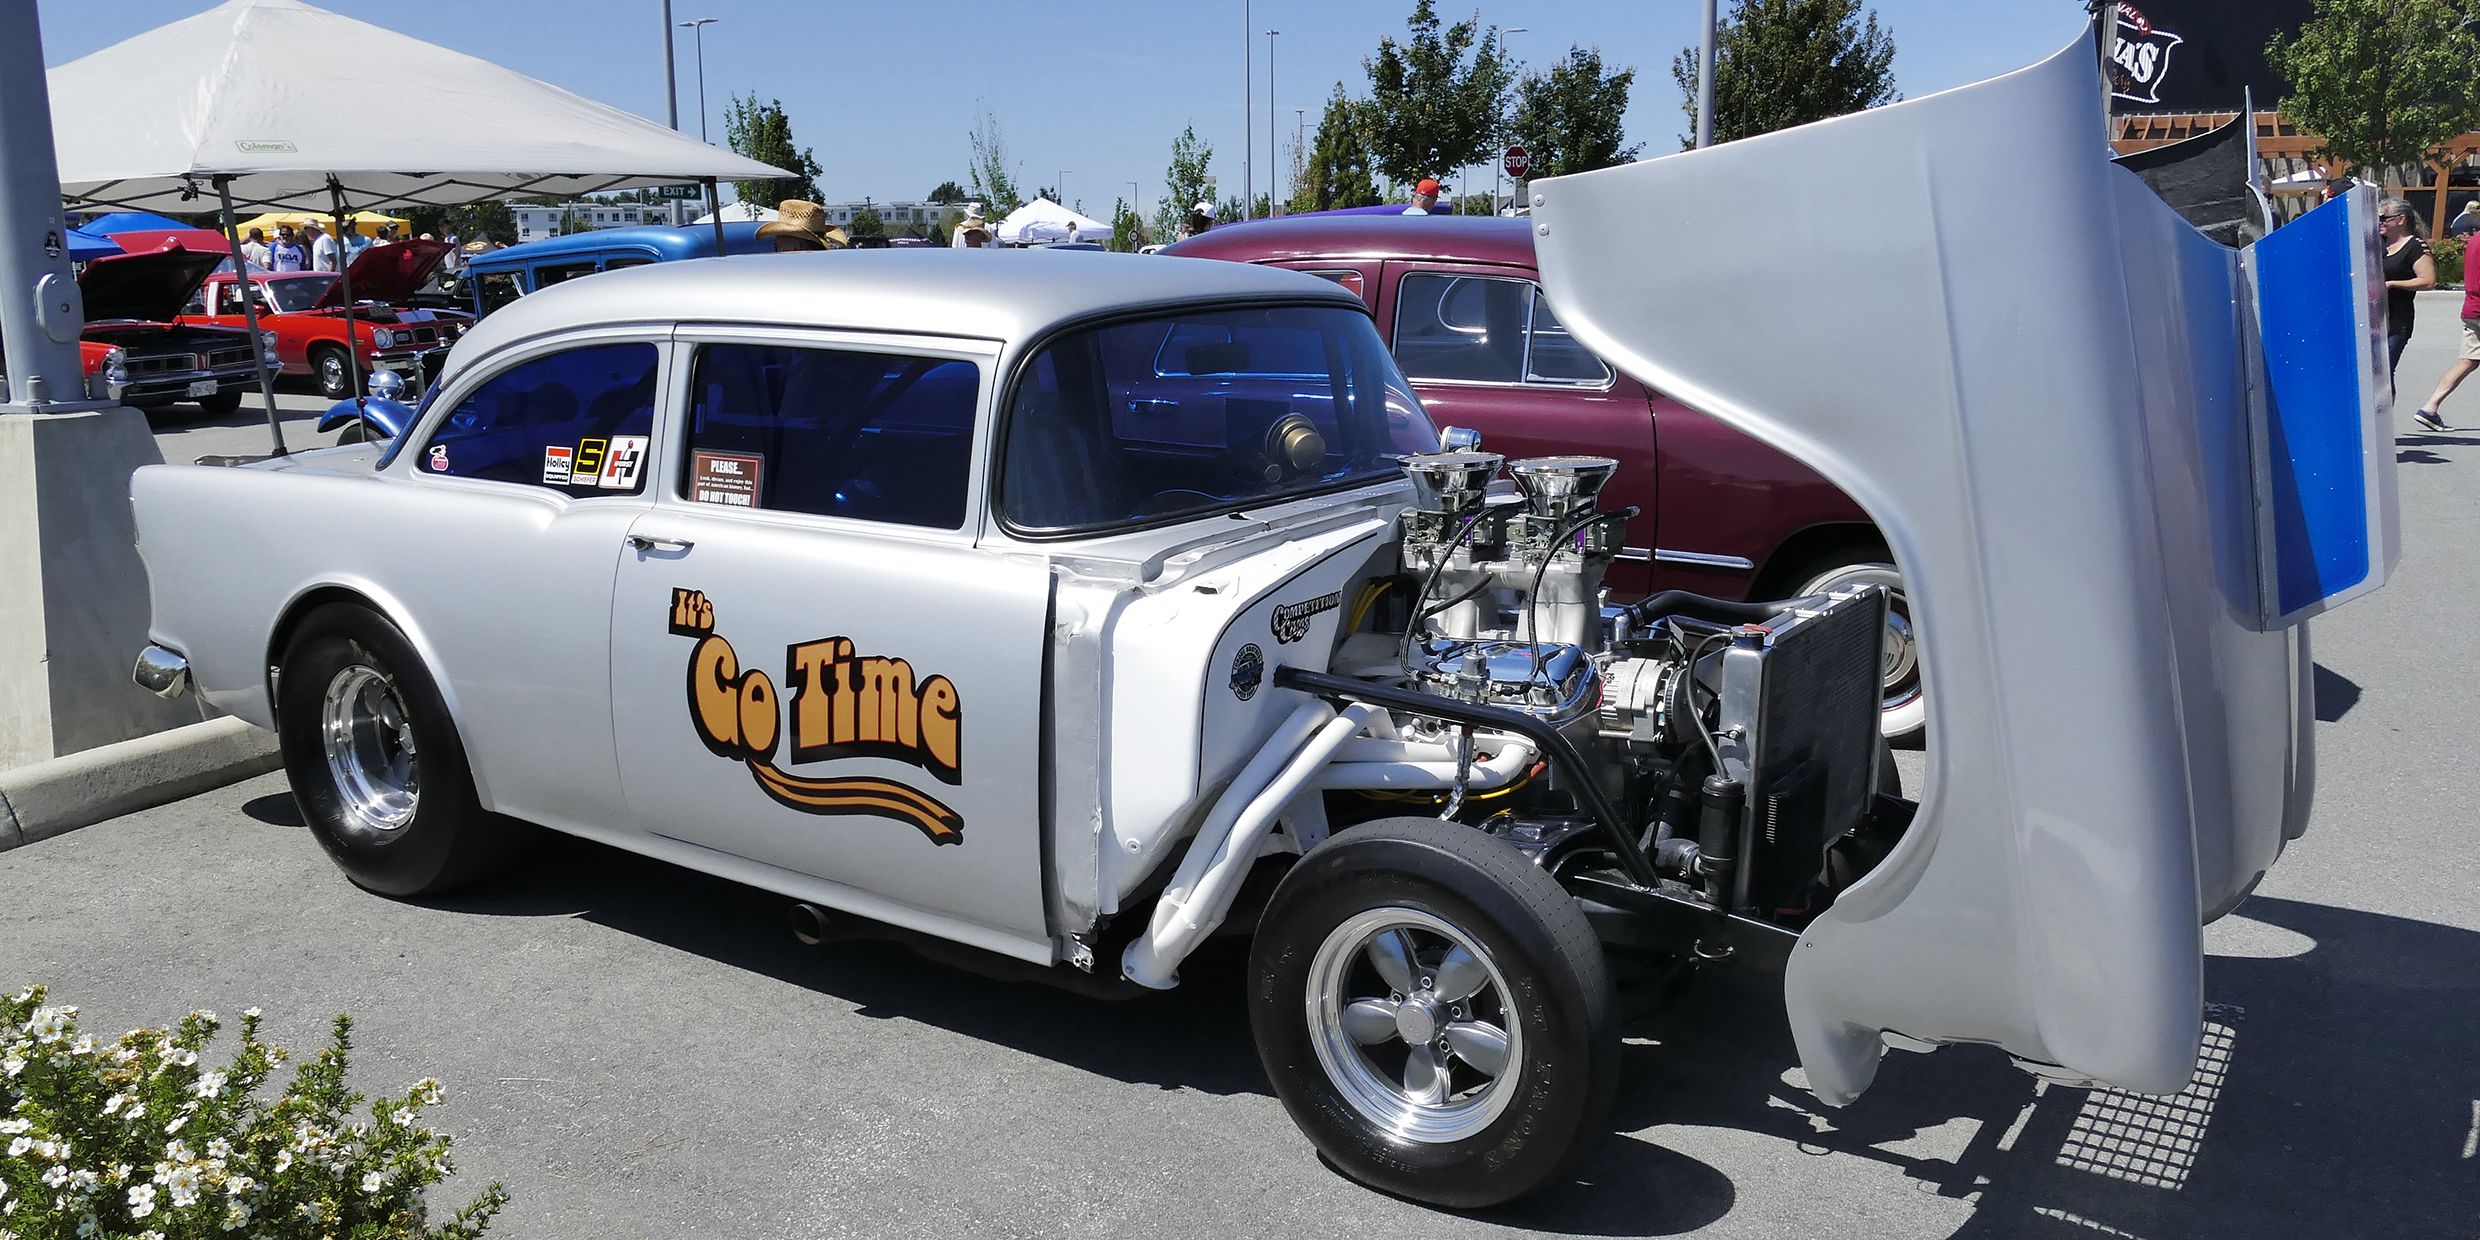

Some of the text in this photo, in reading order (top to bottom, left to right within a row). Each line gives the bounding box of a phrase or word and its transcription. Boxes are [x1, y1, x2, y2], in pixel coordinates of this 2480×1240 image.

[240, 142, 284, 151] Coleman
[1505, 155, 1528, 168] STOP
[663, 186, 685, 196] EXIT
[546, 457, 570, 471] Holley
[573, 476, 596, 484] SCHIEFER
[699, 489, 751, 506] DO NOT TOUCH!
[673, 589, 715, 630] It's
[692, 635, 959, 771] Go Time
